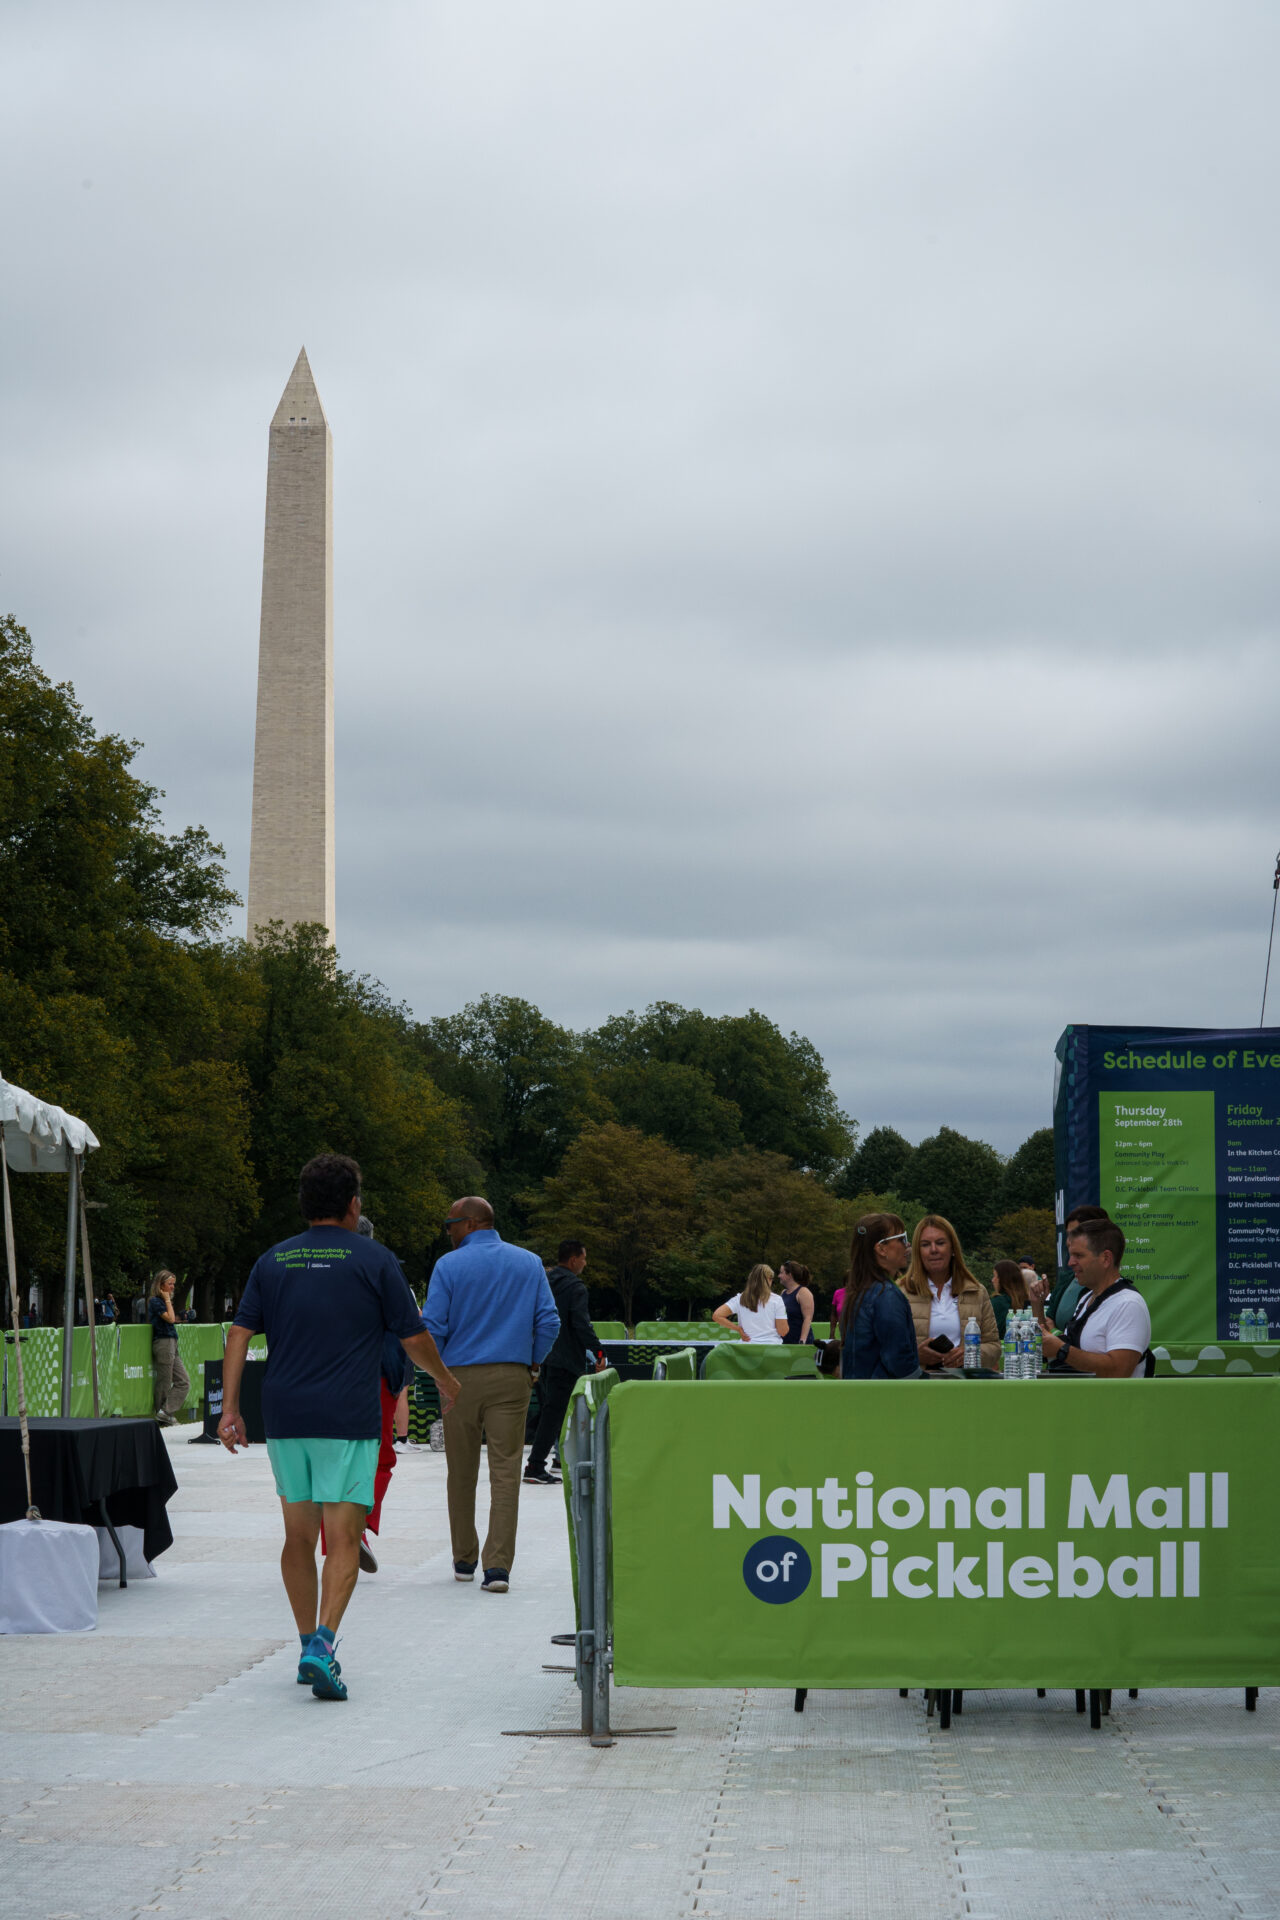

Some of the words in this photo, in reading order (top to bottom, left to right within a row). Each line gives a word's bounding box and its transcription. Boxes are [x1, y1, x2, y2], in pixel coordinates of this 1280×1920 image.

[1103, 1051, 1206, 1069] Schedule
[1212, 1050, 1238, 1068] of
[1115, 1105, 1166, 1118] Thursday
[1227, 1104, 1263, 1117] Friday
[1115, 1118, 1160, 1128] September
[1162, 1118, 1183, 1127] 28th
[1227, 1117, 1274, 1128] September
[1128, 1185, 1158, 1193] Pickleball
[1265, 1227, 1280, 1235] Play
[1242, 1261, 1272, 1269] Pickleball
[712, 1471, 1045, 1530] National
[1067, 1471, 1229, 1530] Mall
[755, 1551, 798, 1582] of
[821, 1540, 1200, 1599] Pickleball
